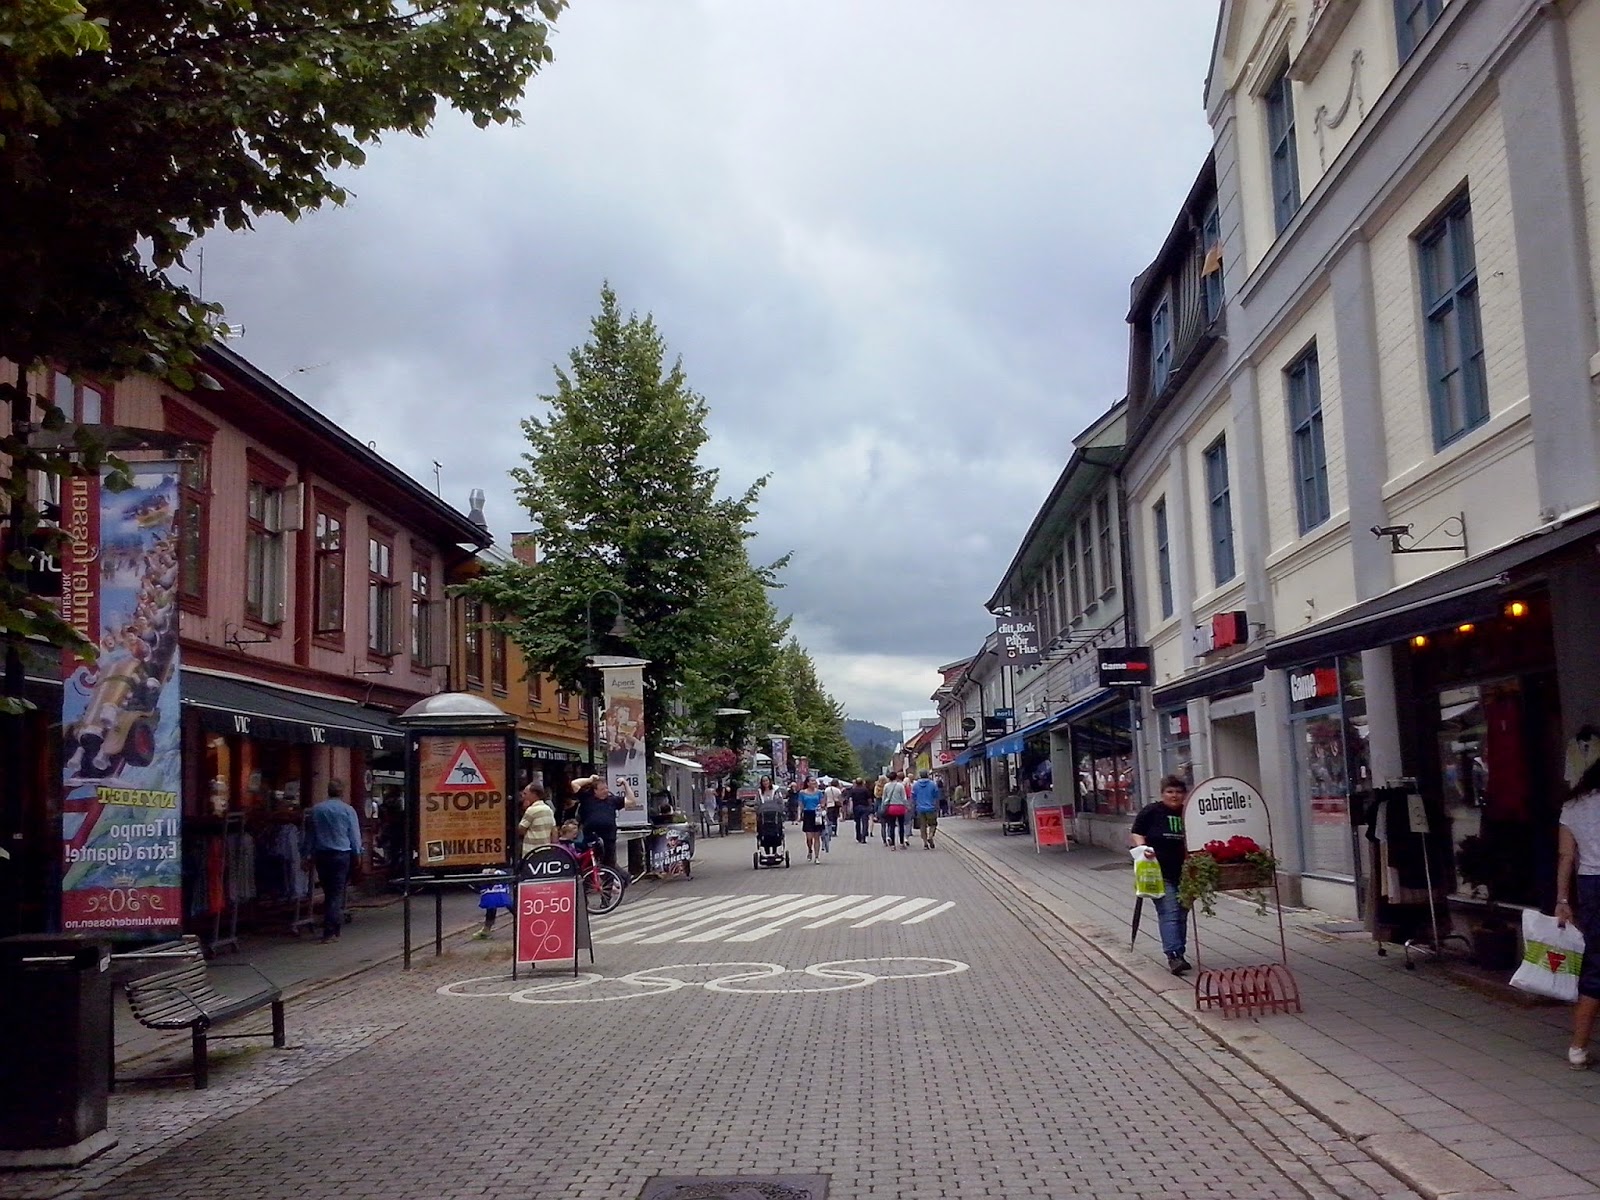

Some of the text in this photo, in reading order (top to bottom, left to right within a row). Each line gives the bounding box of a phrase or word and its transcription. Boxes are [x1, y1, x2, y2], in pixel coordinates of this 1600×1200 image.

[1016, 621, 1036, 633] Bok
[1005, 635, 1029, 648] Papir
[1019, 644, 1038, 654] Hus
[233, 715, 251, 734] VIC
[310, 726, 326, 743] VIC
[371, 735, 384, 749] VIC
[425, 791, 502, 812] STOPP
[1198, 791, 1246, 816] gabrielle
[443, 837, 502, 855] NIKKERS
[527, 861, 562, 875] VIC
[523, 896, 571, 916] 30-50
[530, 919, 562, 960] %
